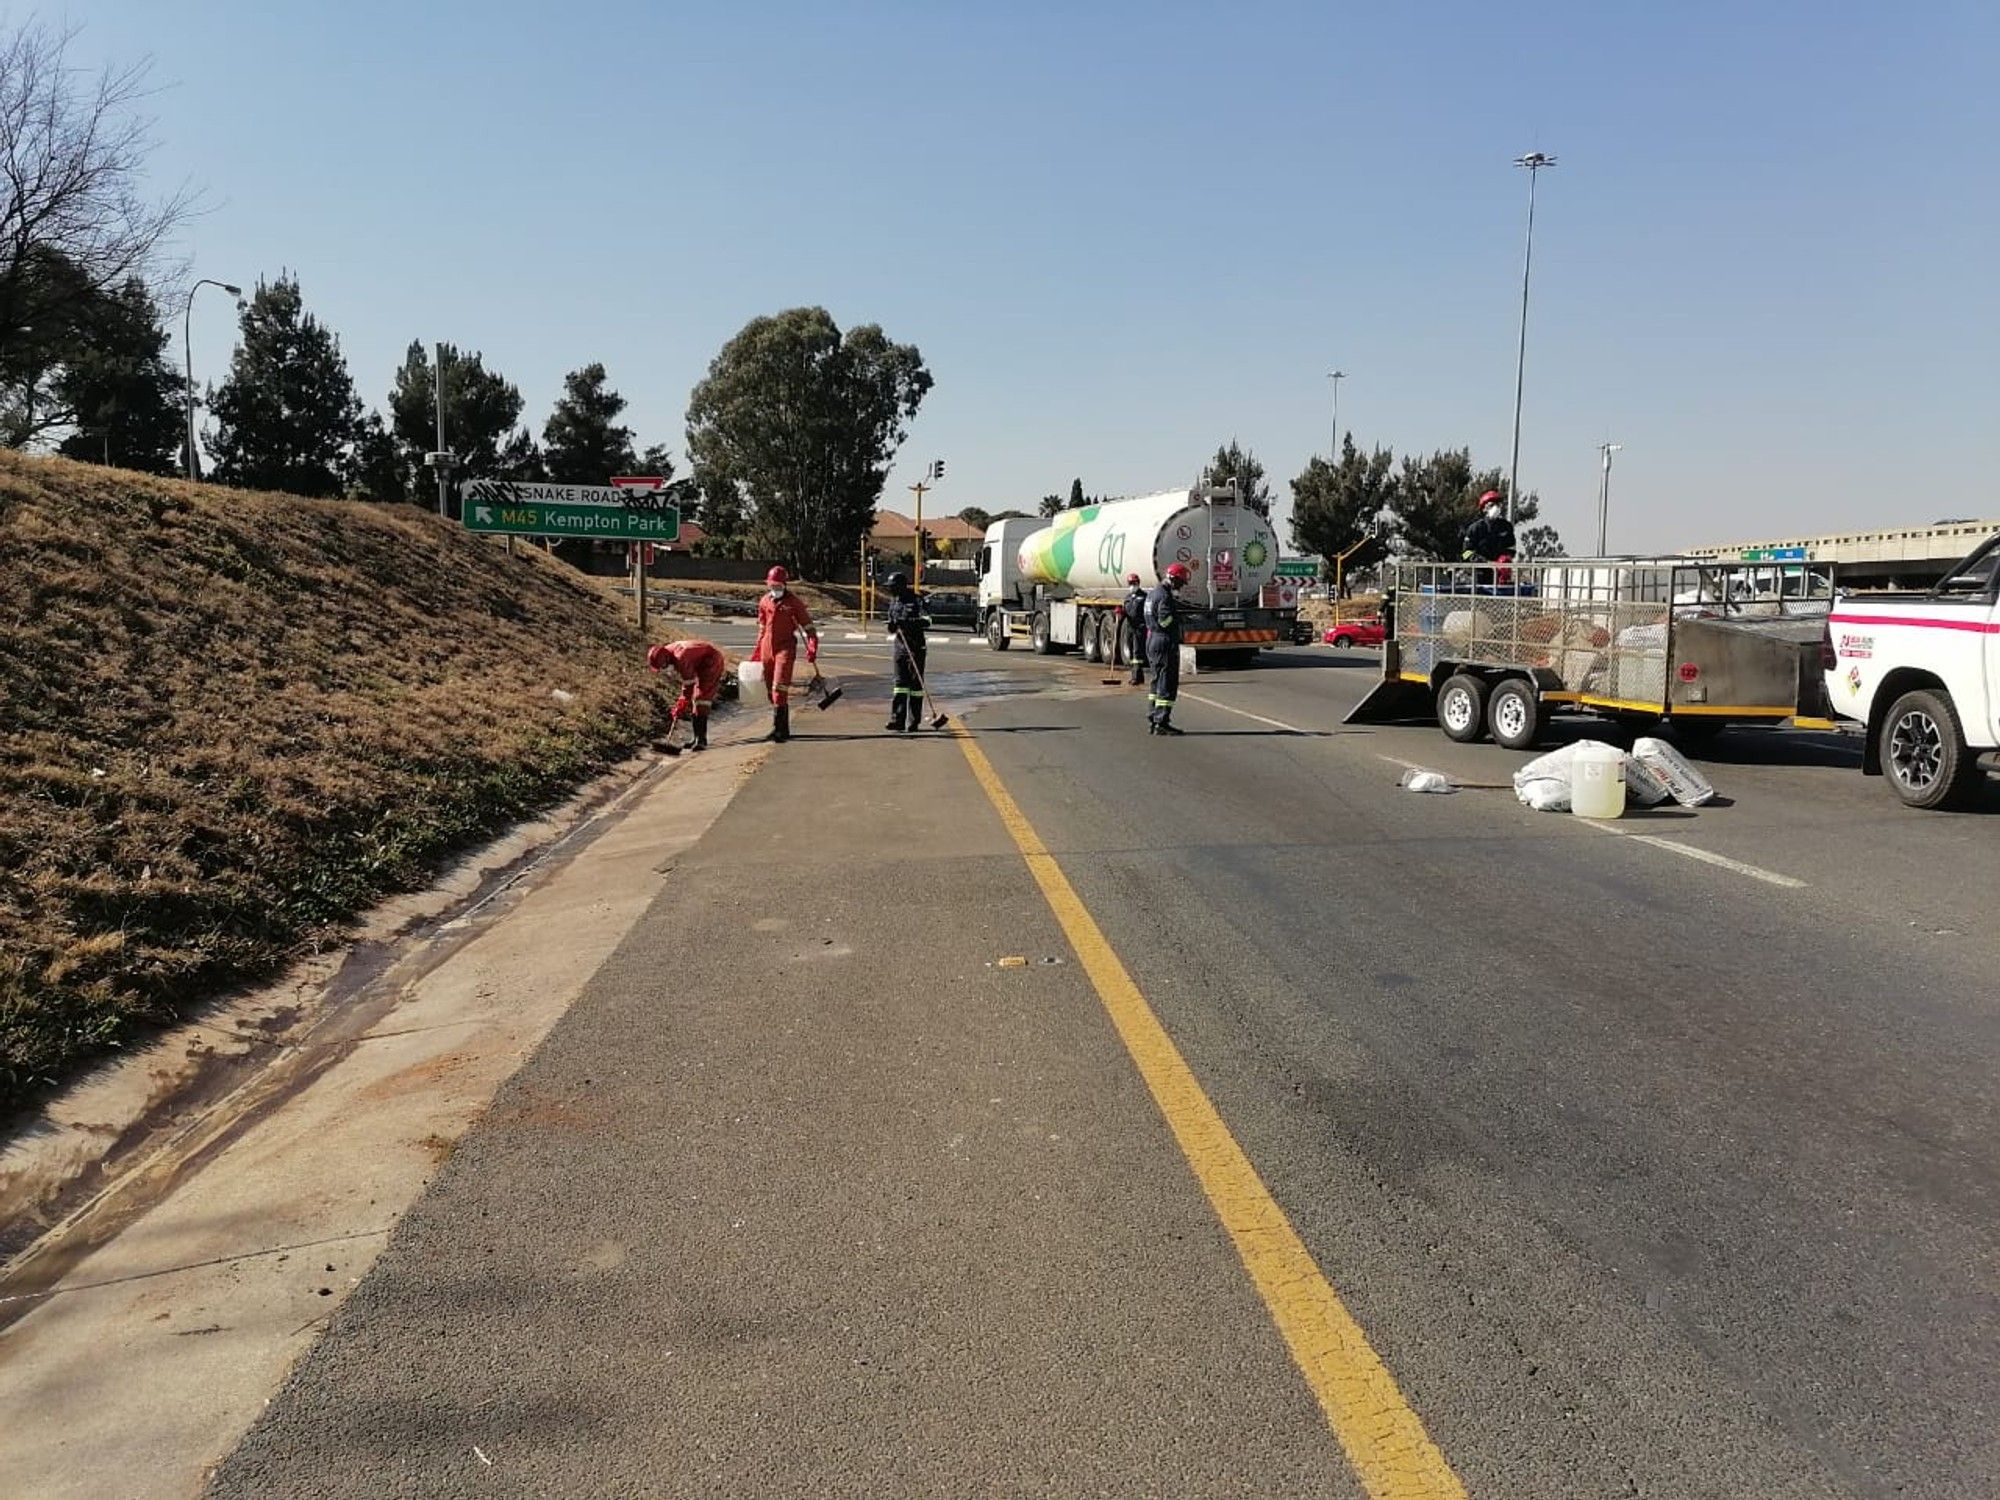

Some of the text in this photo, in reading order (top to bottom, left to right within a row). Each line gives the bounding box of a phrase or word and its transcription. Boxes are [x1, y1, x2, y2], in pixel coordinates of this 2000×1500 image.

[523, 486, 620, 503] SNAKE ROAD
[501, 508, 667, 531] M45 Kempton Park
